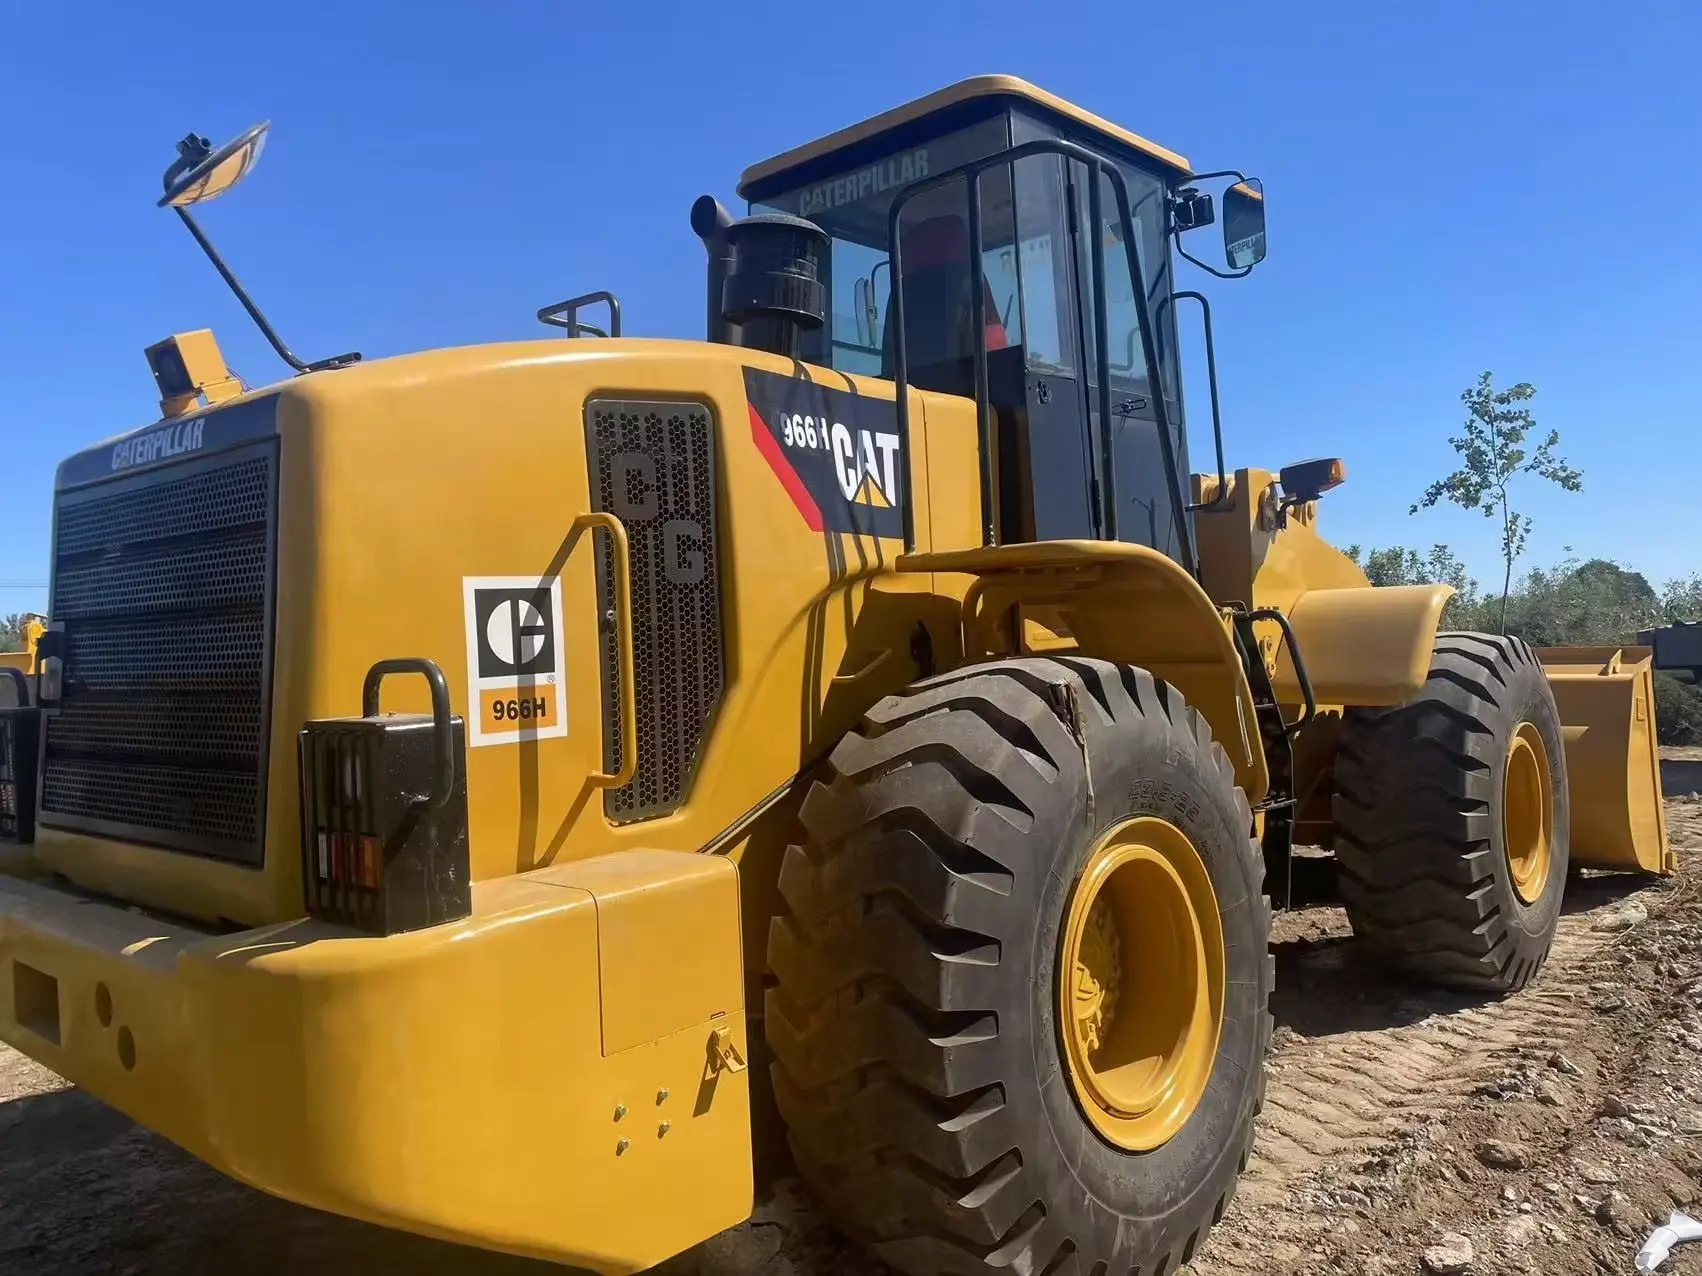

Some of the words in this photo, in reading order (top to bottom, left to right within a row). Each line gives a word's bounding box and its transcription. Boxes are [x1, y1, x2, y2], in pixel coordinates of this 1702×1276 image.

[801, 150, 929, 217] CATERPILLAR
[112, 418, 205, 470] CATERPILLAR
[780, 413, 831, 451] 966H
[832, 423, 899, 507] CAT
[493, 697, 546, 721] 966H
